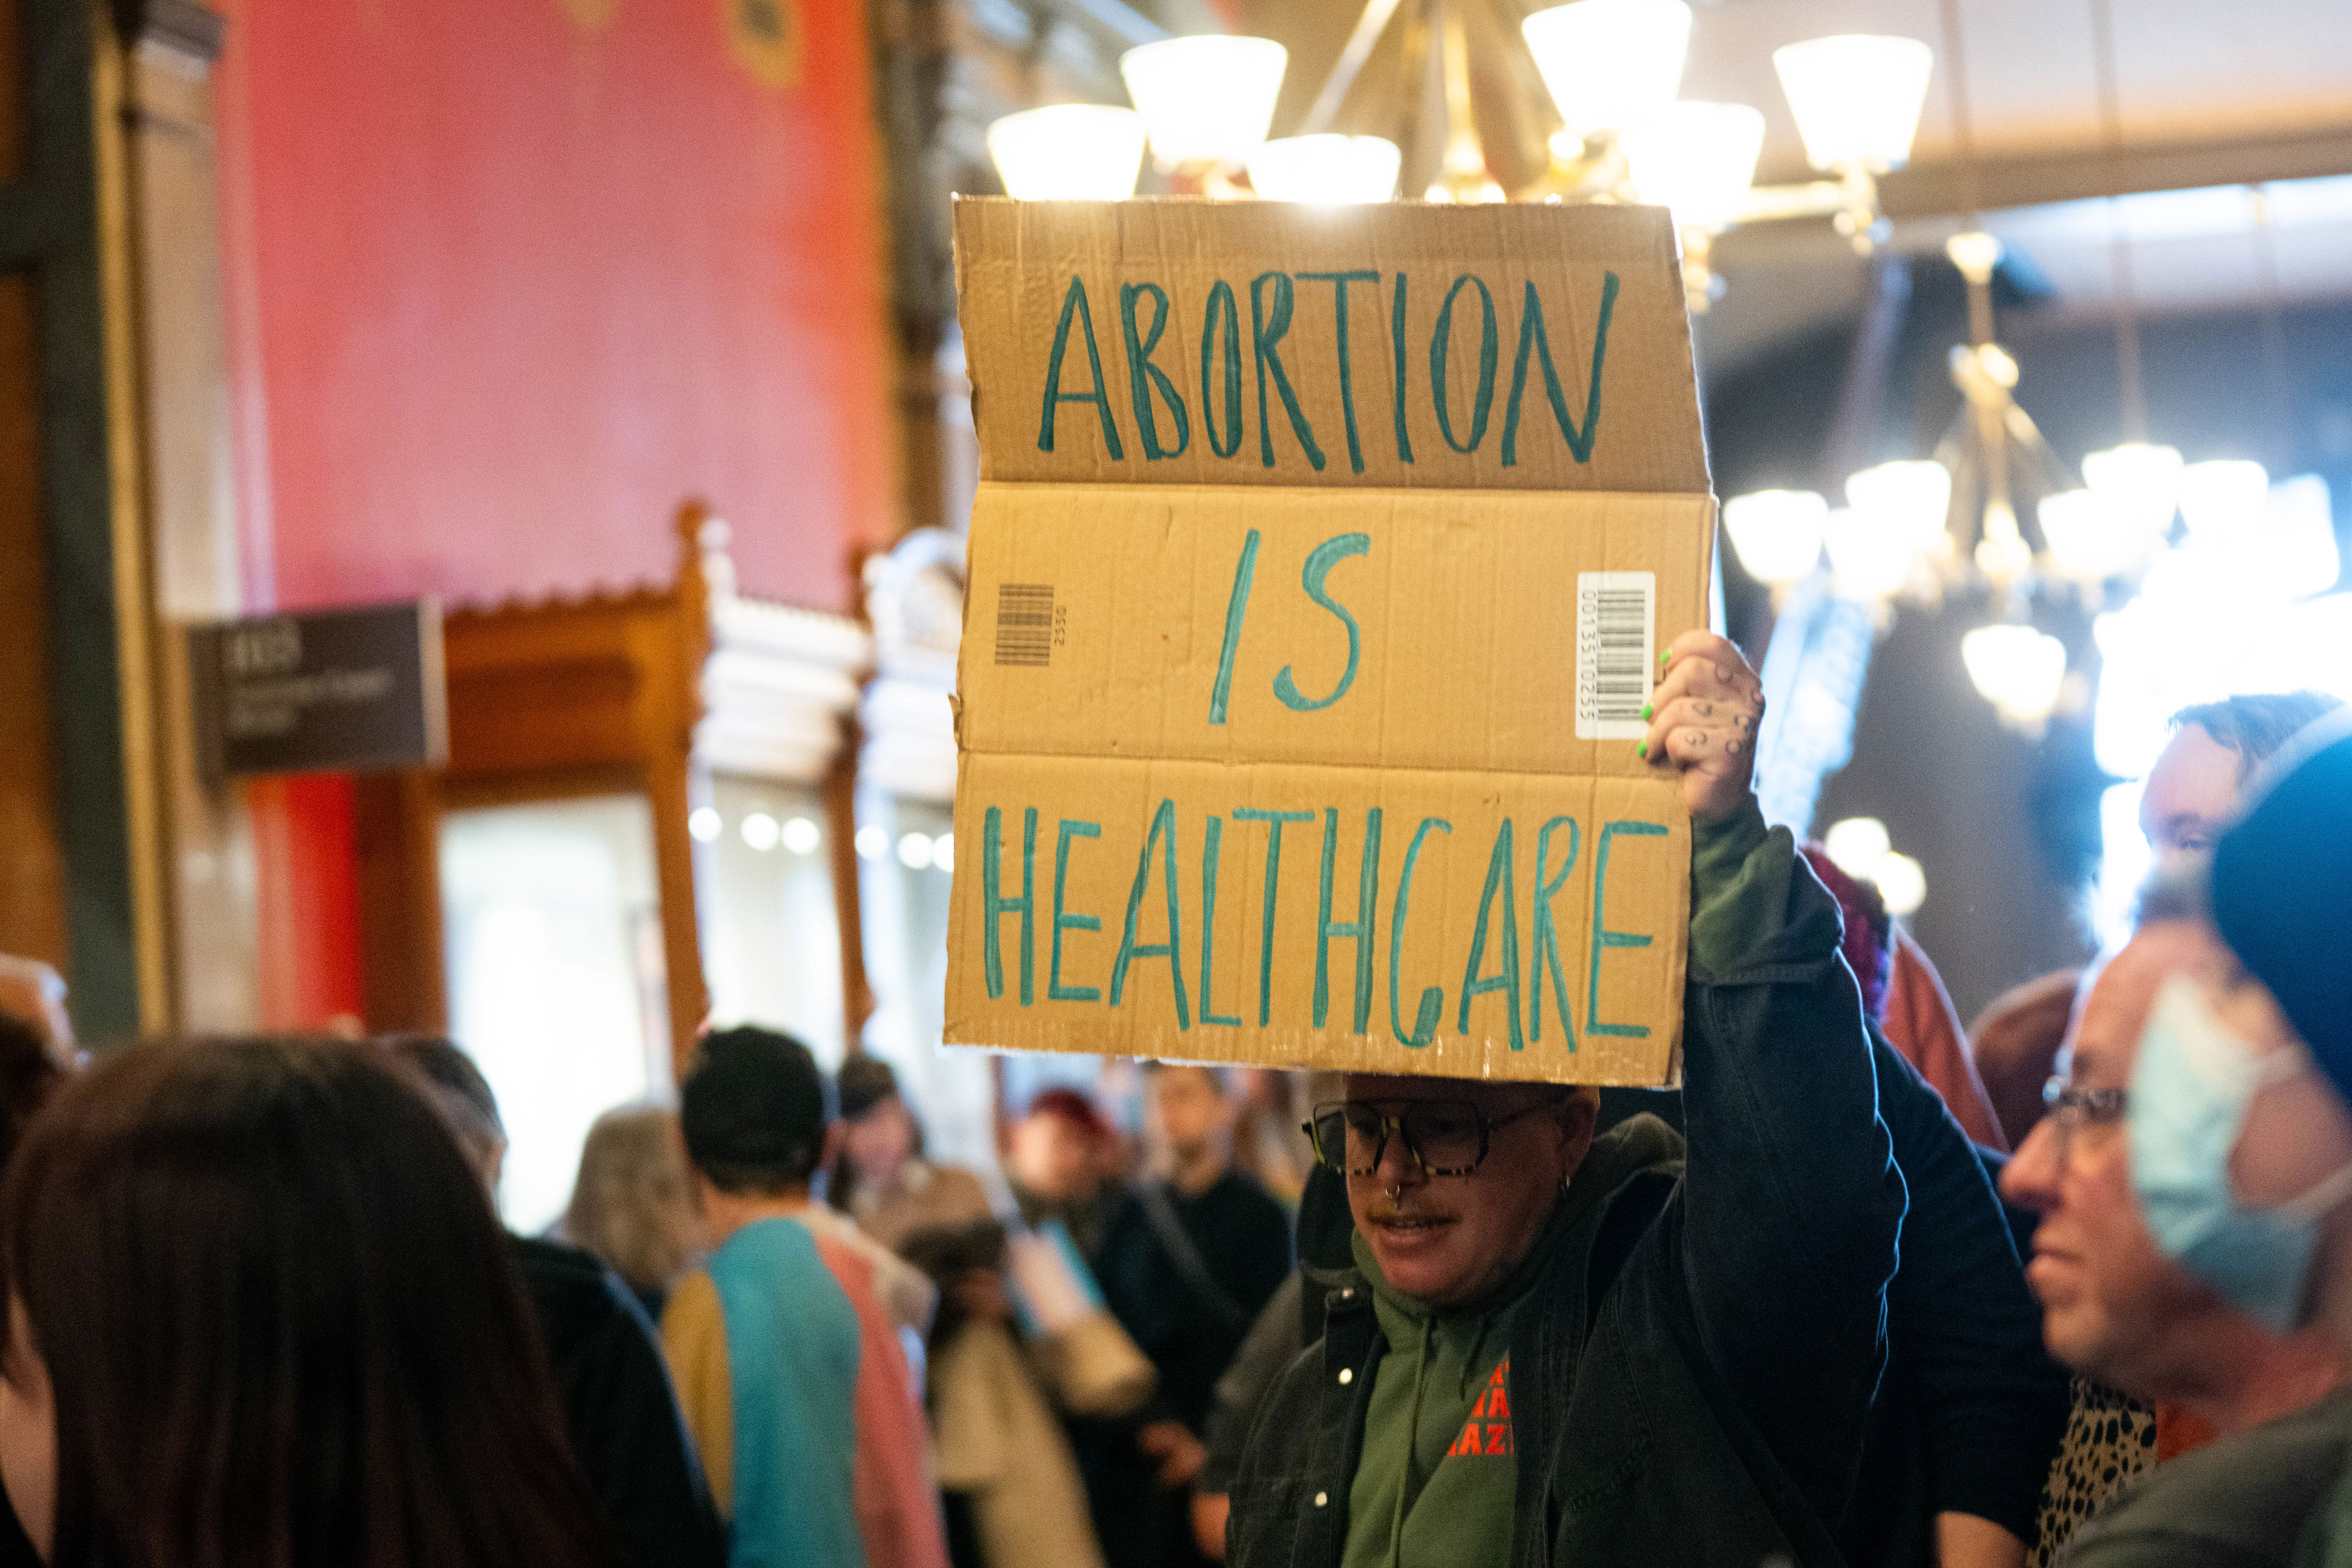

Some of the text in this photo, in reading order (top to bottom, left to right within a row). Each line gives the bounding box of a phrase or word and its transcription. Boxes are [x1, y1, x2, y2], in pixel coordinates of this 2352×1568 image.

[1037, 271, 1620, 474] ABORTION
[1208, 528, 1372, 725] IS
[1580, 589, 1597, 722] 0013510255
[983, 798, 1669, 1053] HEALTHCARE
